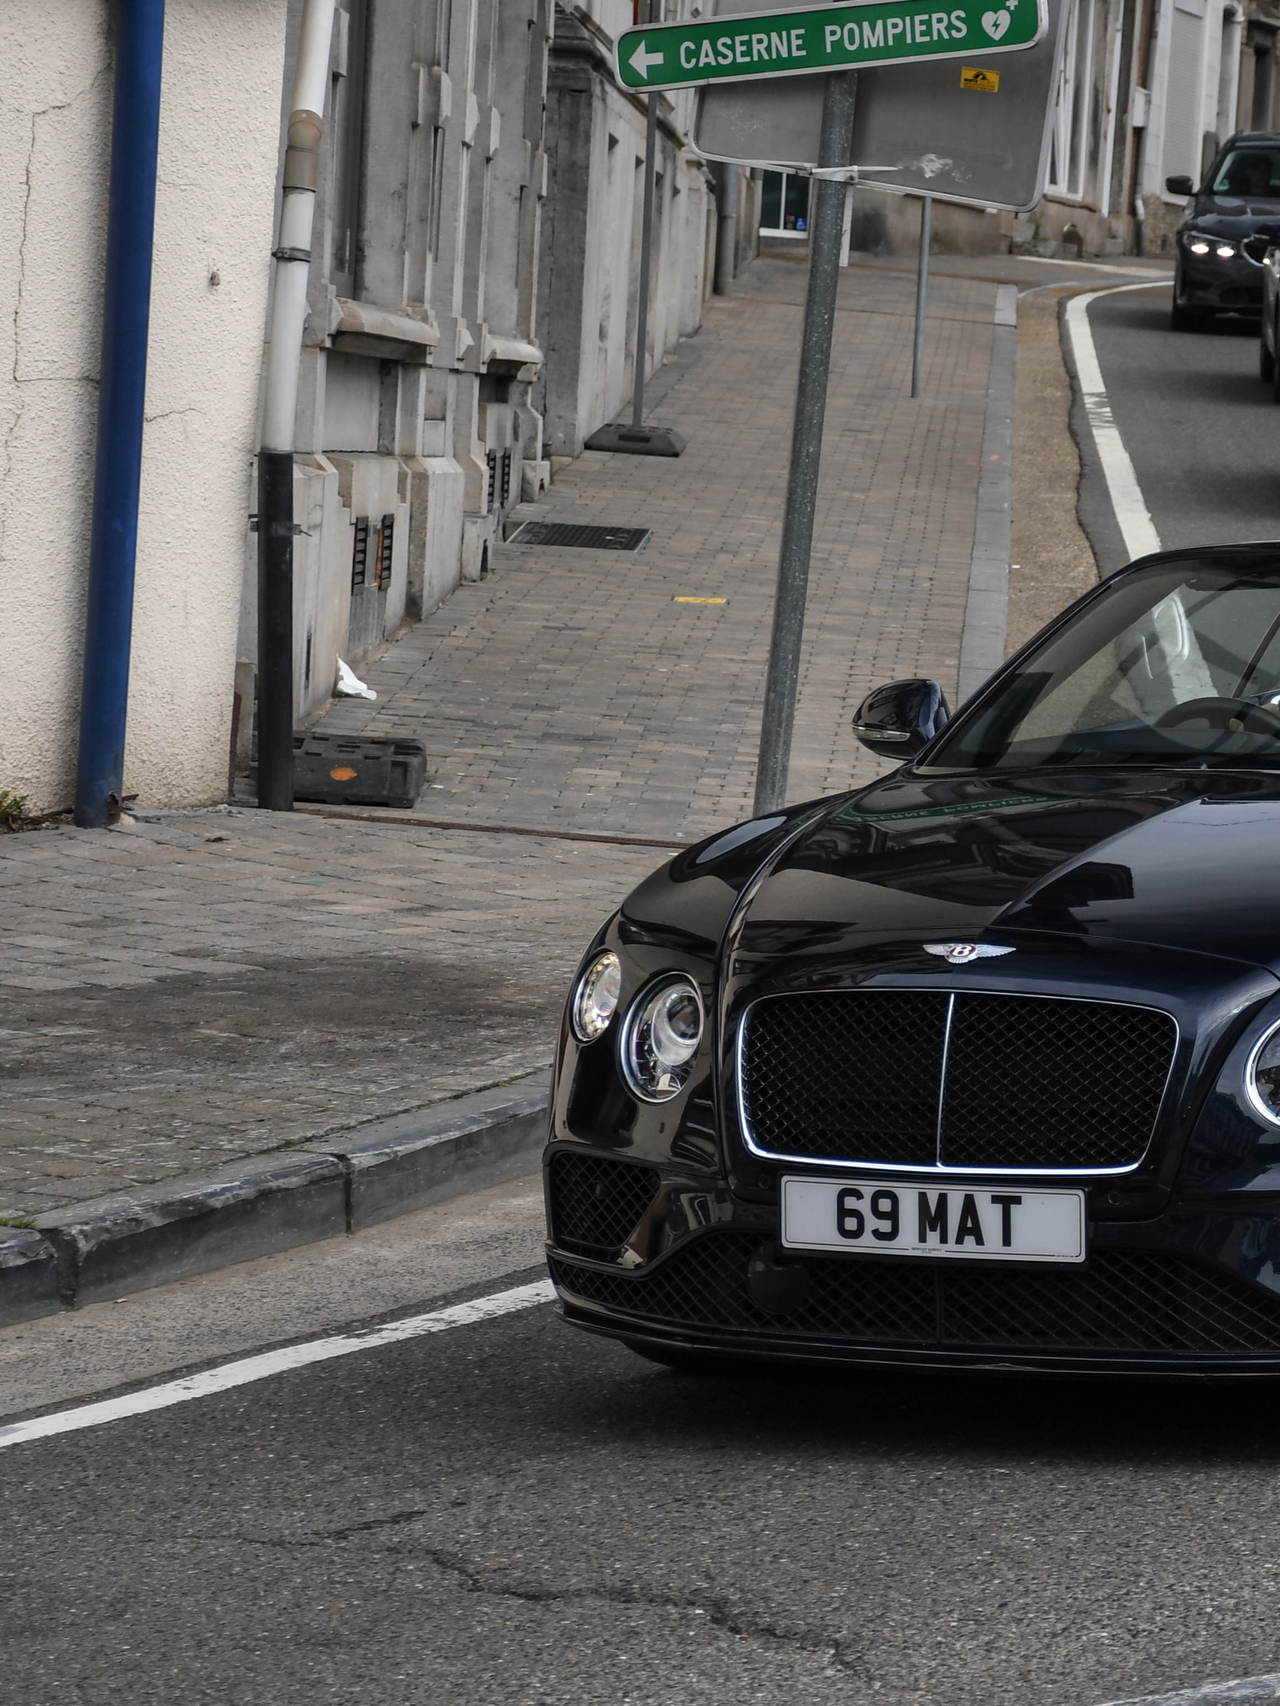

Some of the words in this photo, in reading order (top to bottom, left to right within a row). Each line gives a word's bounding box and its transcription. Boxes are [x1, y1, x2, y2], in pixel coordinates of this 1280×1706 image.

[679, 28, 807, 70] CASERNE
[825, 9, 968, 53] POMPIERS
[951, 945, 972, 957] B
[836, 1187, 900, 1242] 69
[917, 1191, 1023, 1248] MAT
